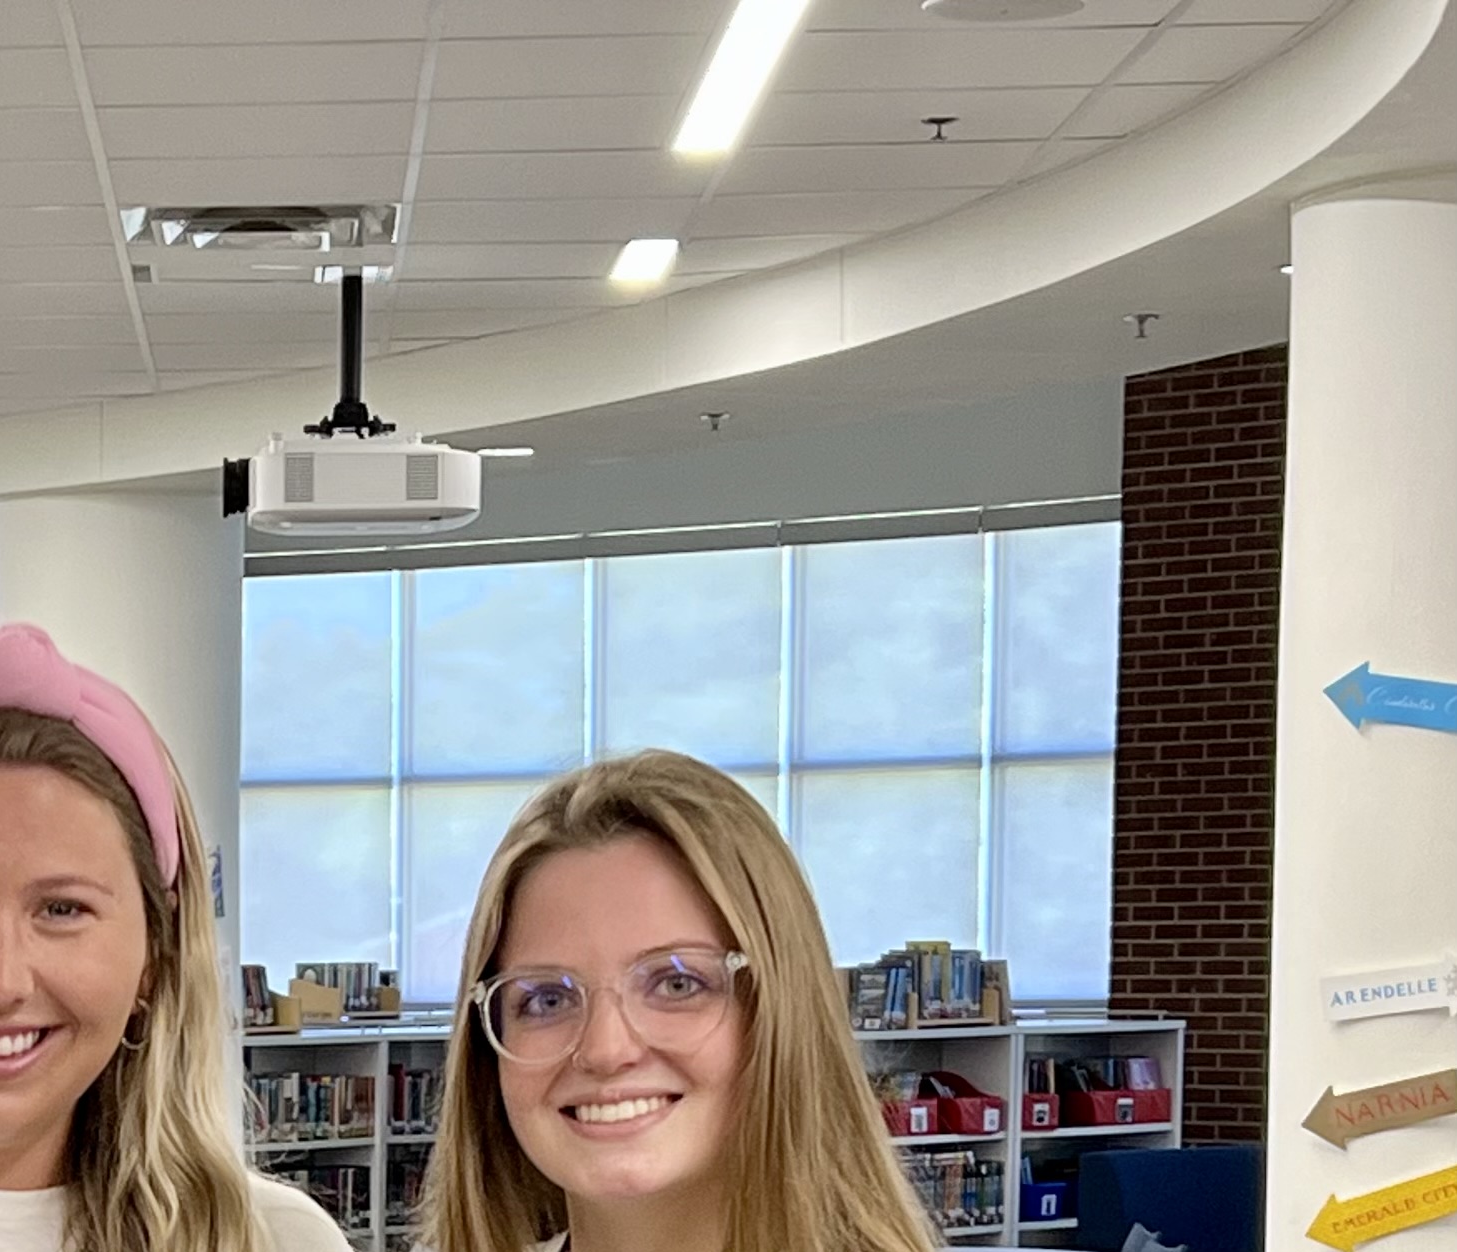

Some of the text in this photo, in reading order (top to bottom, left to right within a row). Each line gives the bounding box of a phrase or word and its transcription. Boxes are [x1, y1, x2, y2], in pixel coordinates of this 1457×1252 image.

[1329, 978, 1438, 1007] ARENDELLE
[1334, 1082, 1450, 1127] NARNIA
[1332, 1196, 1416, 1234] EMERALD
